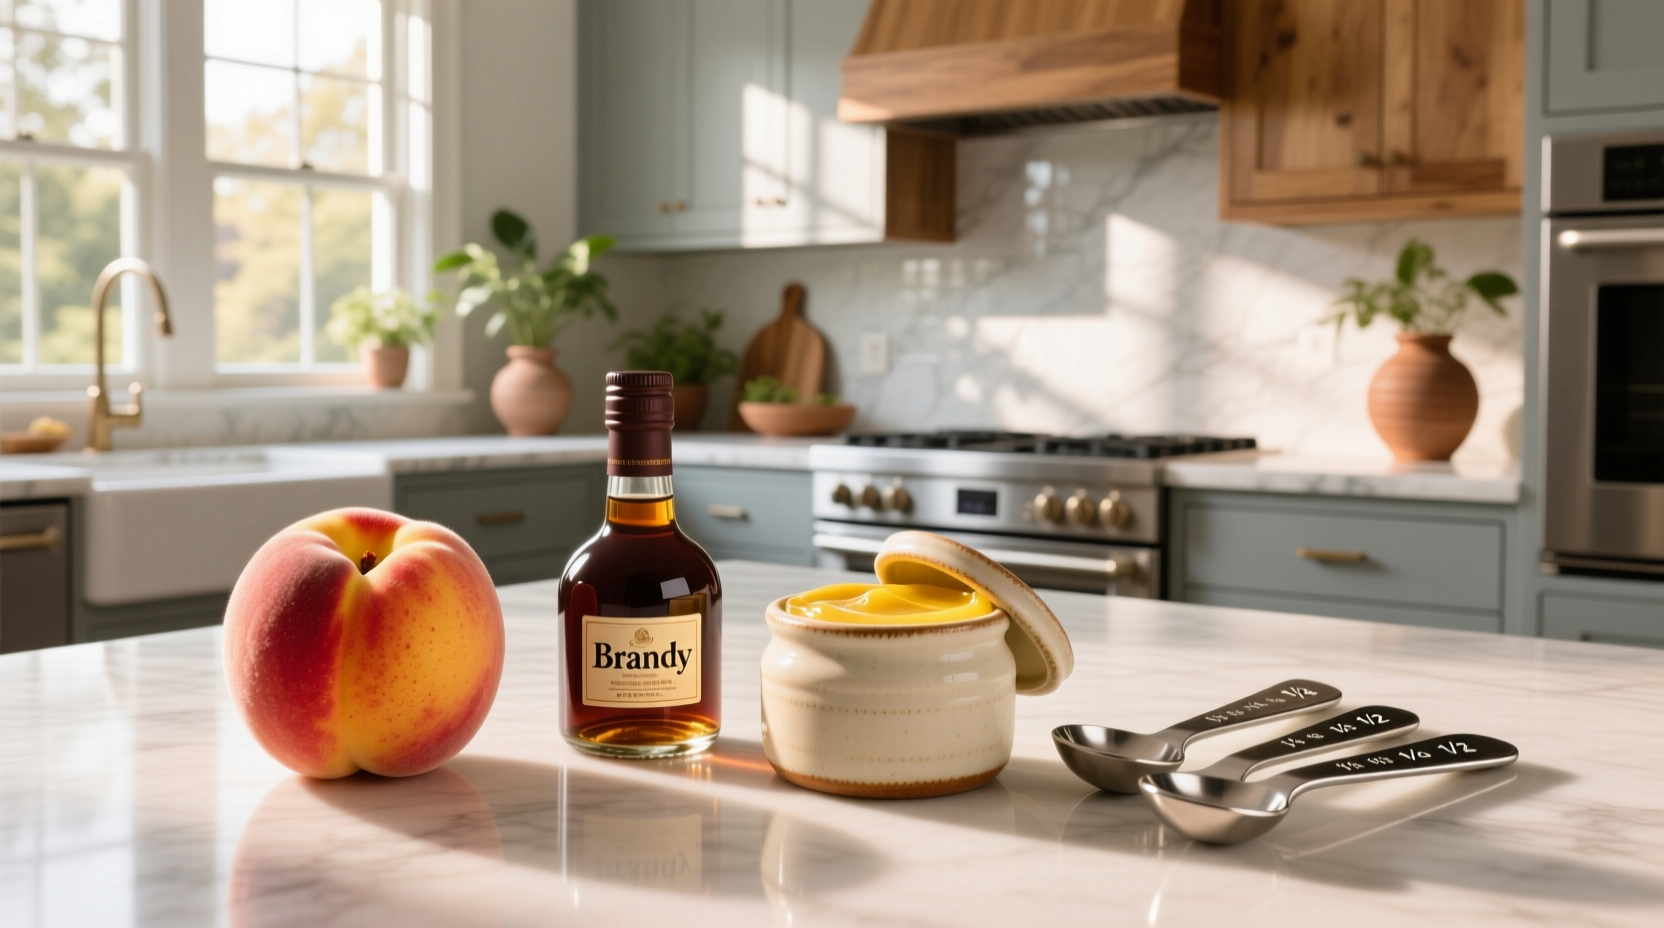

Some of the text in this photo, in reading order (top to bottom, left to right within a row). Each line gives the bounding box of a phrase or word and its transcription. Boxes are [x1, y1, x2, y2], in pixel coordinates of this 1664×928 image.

[592, 641, 693, 675] Brandy
[1356, 713, 1391, 725] 1/2
[1438, 741, 1477, 755] 1/2
